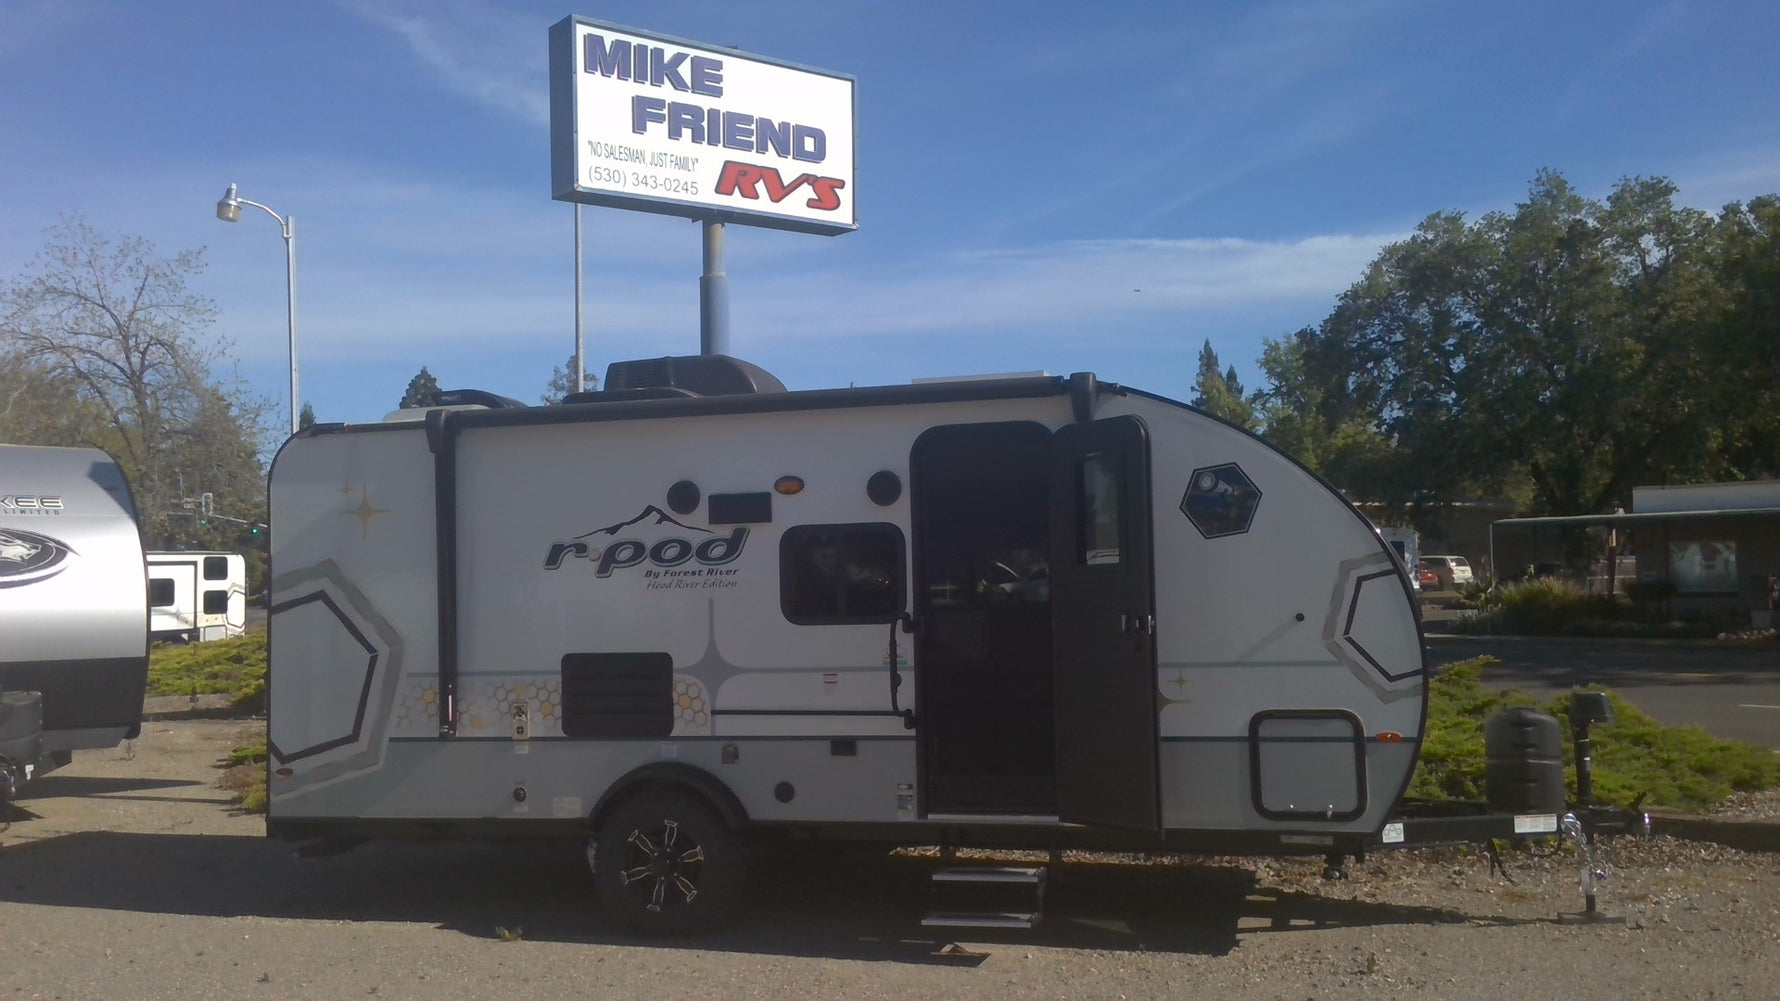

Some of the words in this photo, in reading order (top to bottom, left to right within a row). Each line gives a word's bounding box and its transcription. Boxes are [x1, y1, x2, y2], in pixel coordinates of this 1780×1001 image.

[583, 33, 724, 98] MIKE
[631, 94, 827, 164] FRIEND
[604, 143, 647, 167] SALESMAN,
[649, 151, 668, 168] JUST
[588, 166, 627, 188] (530)
[631, 172, 699, 196] 343-0245
[714, 160, 846, 211] RV'S
[644, 569, 660, 579] By
[663, 569, 703, 577] Forest
[706, 568, 740, 576] River
[646, 579, 673, 591] Hood
[674, 579, 700, 589] River
[702, 578, 738, 589] Edition
